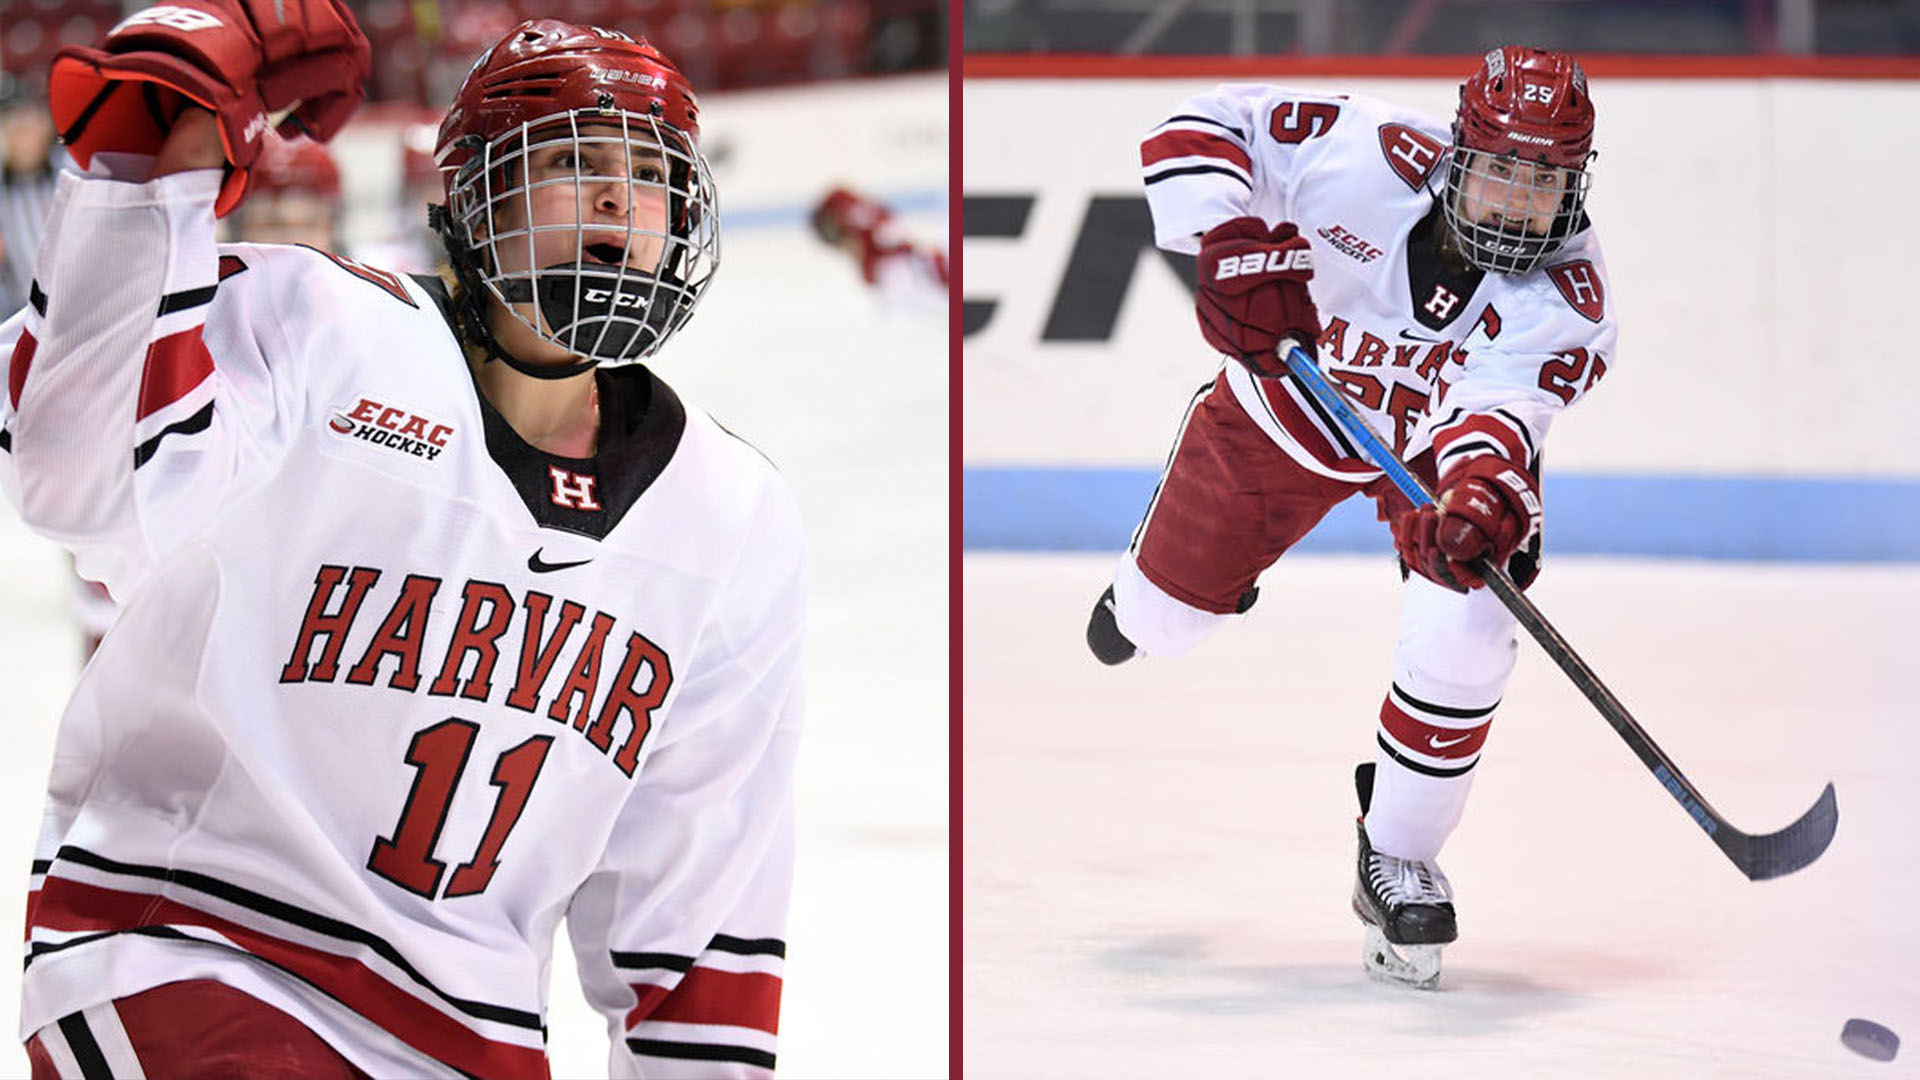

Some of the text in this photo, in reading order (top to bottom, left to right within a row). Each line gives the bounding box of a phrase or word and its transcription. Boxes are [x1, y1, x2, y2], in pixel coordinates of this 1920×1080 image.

[1523, 84, 1555, 104] 25
[1391, 131, 1435, 175] H
[1328, 225, 1384, 260] ECAC
[1328, 238, 1372, 263] HOCKEY
[1485, 240, 1526, 254] CCM
[584, 288, 654, 312] CCM
[1423, 284, 1460, 320] H
[1563, 266, 1598, 304] H
[347, 398, 454, 447] ECAC
[353, 425, 442, 461] HOCKEY
[548, 464, 602, 511] H
[366, 717, 555, 901] 11
